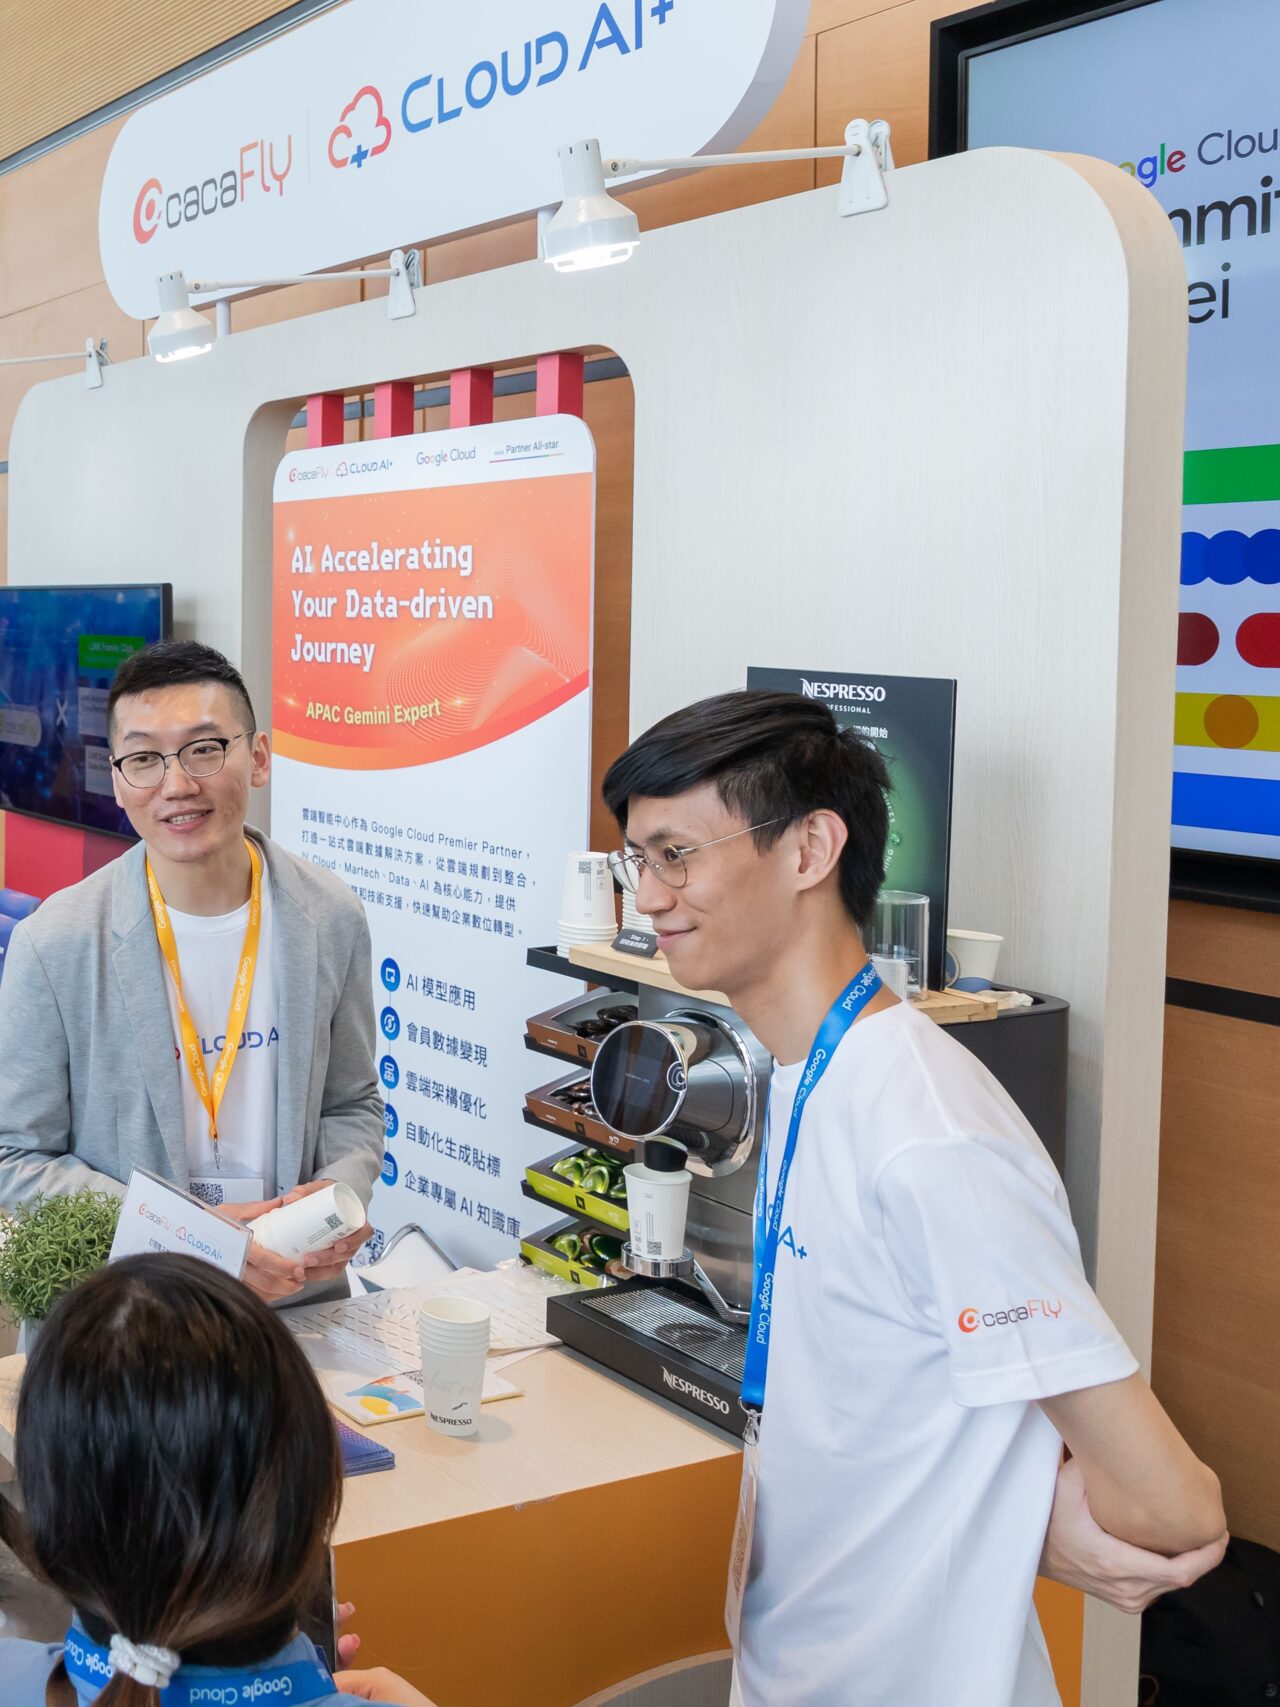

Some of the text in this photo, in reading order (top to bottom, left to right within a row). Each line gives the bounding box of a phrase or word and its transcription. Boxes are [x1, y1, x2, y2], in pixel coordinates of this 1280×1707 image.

[401, 31, 569, 134] CLOUD
[1197, 128, 1280, 166] Clou
[416, 447, 476, 467] Google Cloud
[506, 443, 532, 455] Partner
[532, 439, 559, 452] All-star
[291, 538, 473, 576] AI Accelerating
[291, 587, 493, 619] Your Data-driven
[290, 633, 376, 673] Journey
[799, 677, 886, 702] NESPRESSO
[305, 698, 442, 727] APAC Gemini Expert
[825, 703, 871, 714] FESSIONAL
[371, 820, 404, 838] Google
[406, 827, 434, 844] Cloud
[438, 833, 478, 852] Premier
[233, 956, 252, 1012] Google Cloud
[406, 973, 476, 1011] AI 模型應用
[842, 984, 867, 1011] Cloud
[199, 1030, 265, 1055] LOUD
[219, 1042, 235, 1072] Google
[406, 1021, 488, 1068] 會員數據變現
[405, 1070, 487, 1120] 雲端架構優化
[792, 1048, 827, 1119] Google Cloud
[405, 1121, 502, 1178] 自動化生成貼標
[404, 1169, 521, 1241] 企業專屬 AI 知識庫
[772, 1199, 783, 1232] Cloud
[756, 1271, 775, 1345] Google Cloud
[659, 1365, 730, 1415] NESPRESSO
[430, 1411, 473, 1426] NESPRESSO
[85, 1652, 114, 1678] oogle
[189, 1676, 293, 1705] Google Cloud
